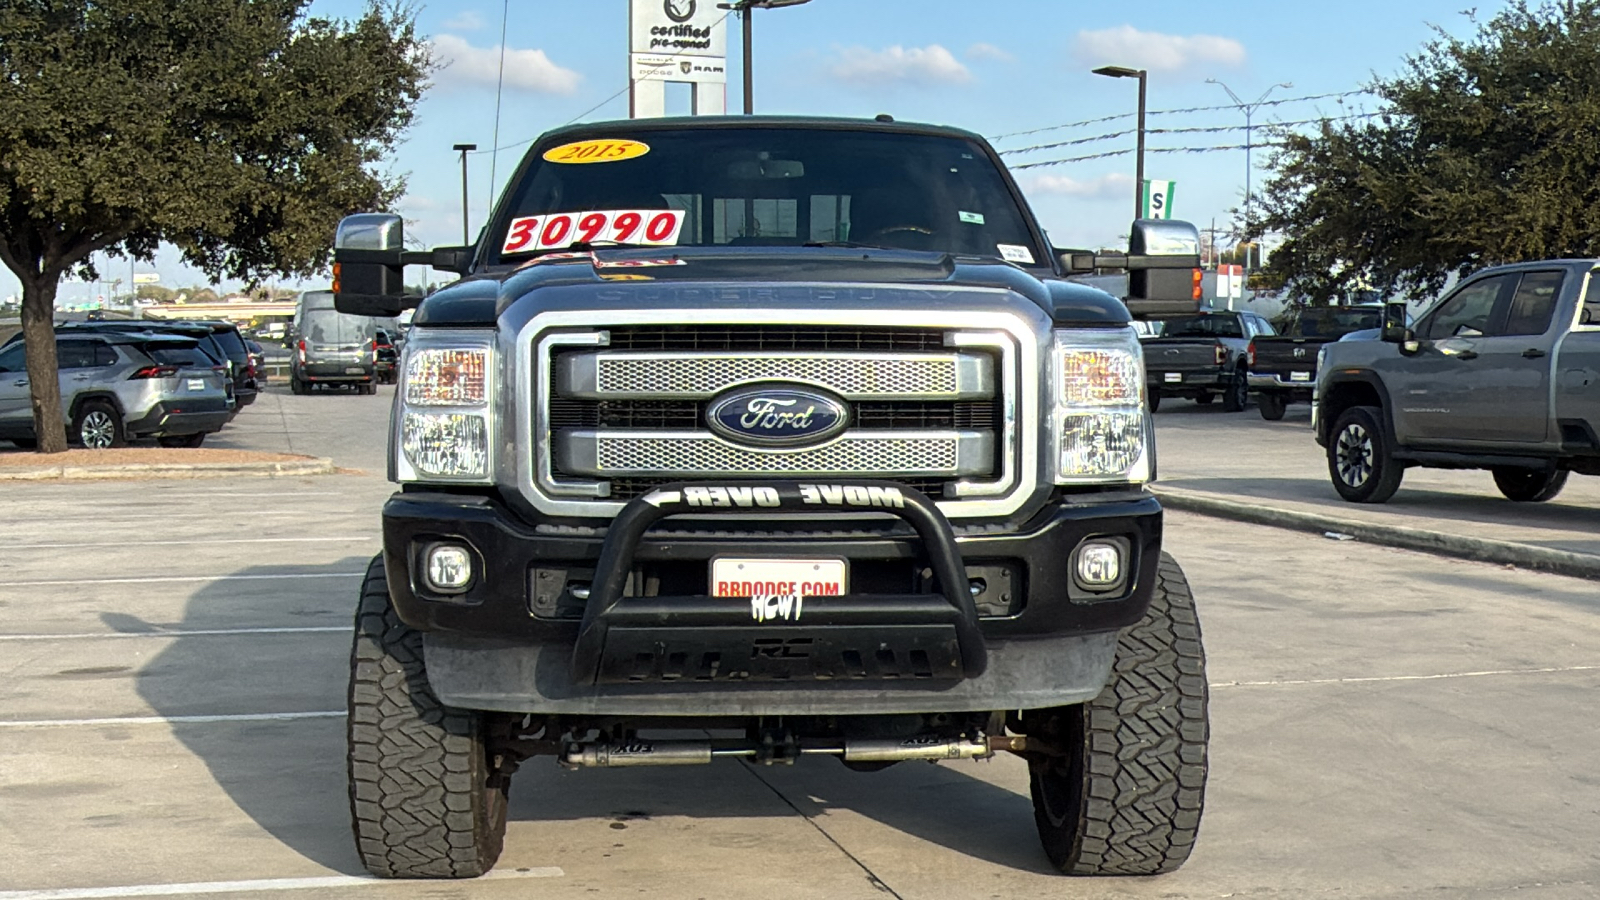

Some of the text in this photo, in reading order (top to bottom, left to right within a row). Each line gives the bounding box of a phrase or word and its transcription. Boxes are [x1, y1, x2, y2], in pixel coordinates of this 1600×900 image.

[650, 24, 711, 38] certified
[650, 38, 711, 50] pre-owned
[694, 65, 724, 73] RAM
[559, 143, 633, 160] 2015
[505, 212, 677, 251] 30990
[740, 398, 815, 429] Ford
[750, 638, 814, 659] RC
